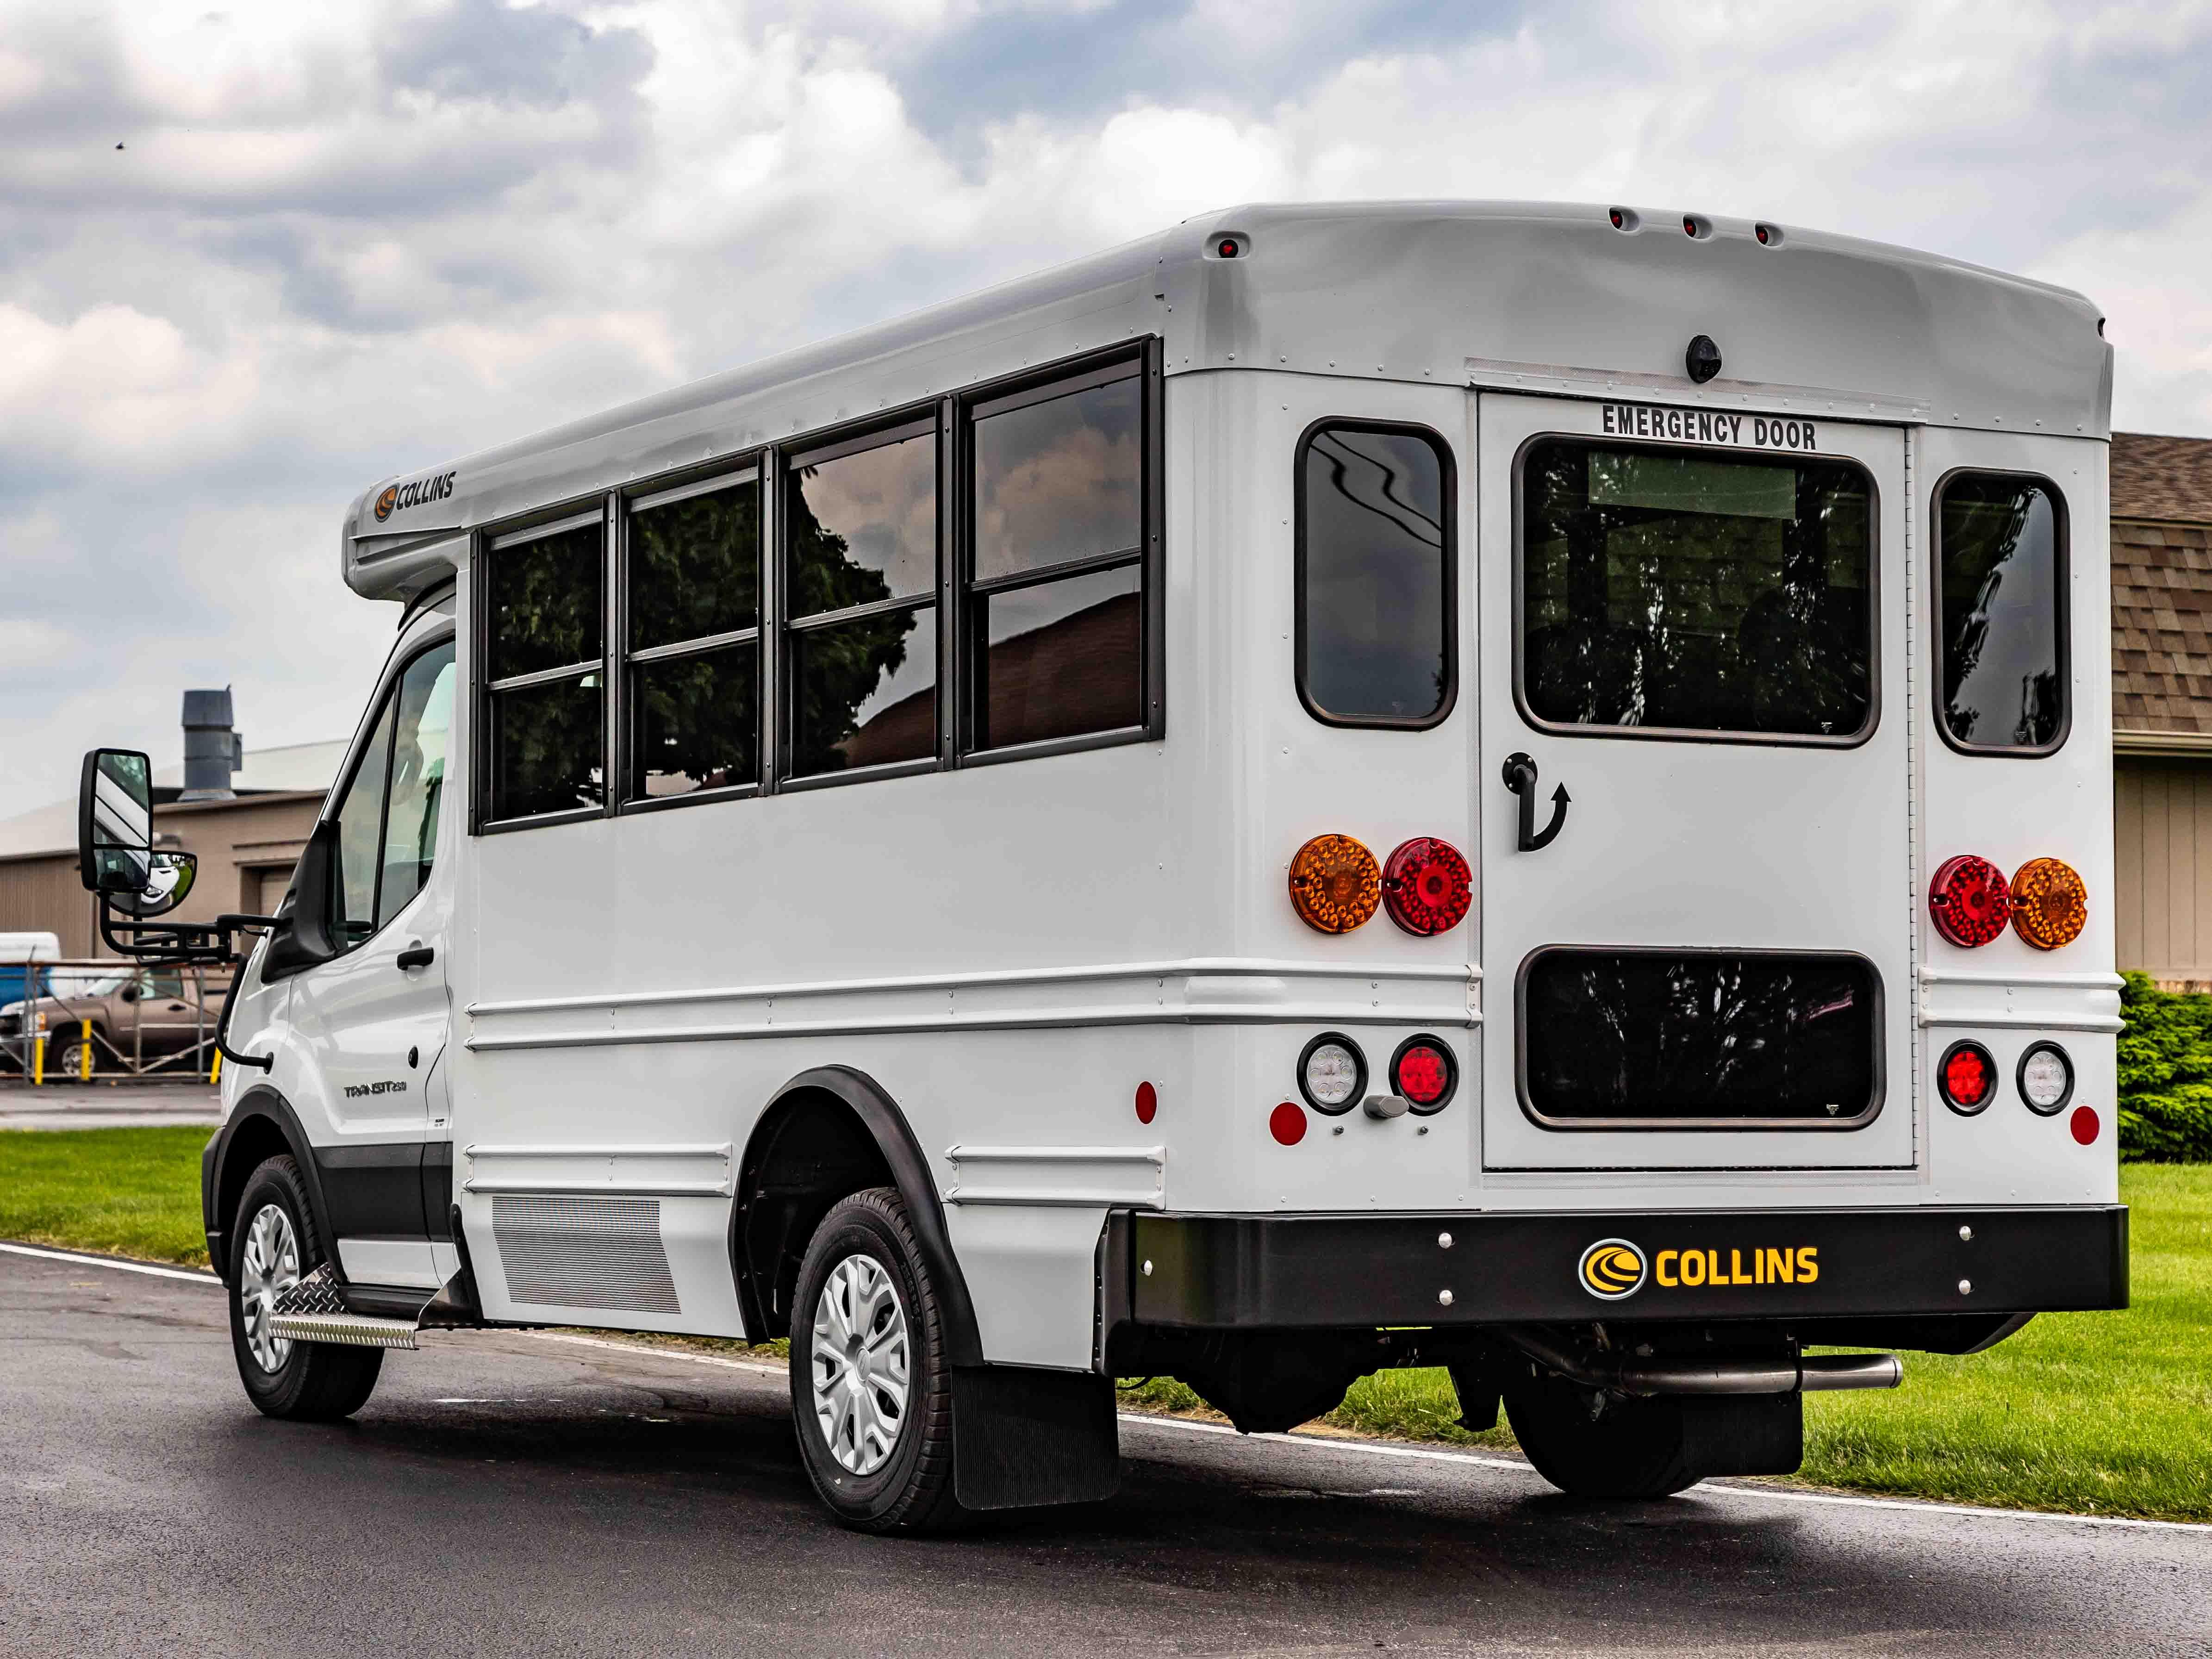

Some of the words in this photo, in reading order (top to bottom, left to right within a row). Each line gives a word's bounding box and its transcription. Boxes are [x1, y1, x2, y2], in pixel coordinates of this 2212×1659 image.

[1602, 405, 1742, 443] EMERGENCY
[1754, 418, 1816, 450] DOOR
[396, 471, 457, 510] COLLINS
[343, 1081, 393, 1098] TRANSIT
[1656, 1247, 1819, 1287] COLLINS
